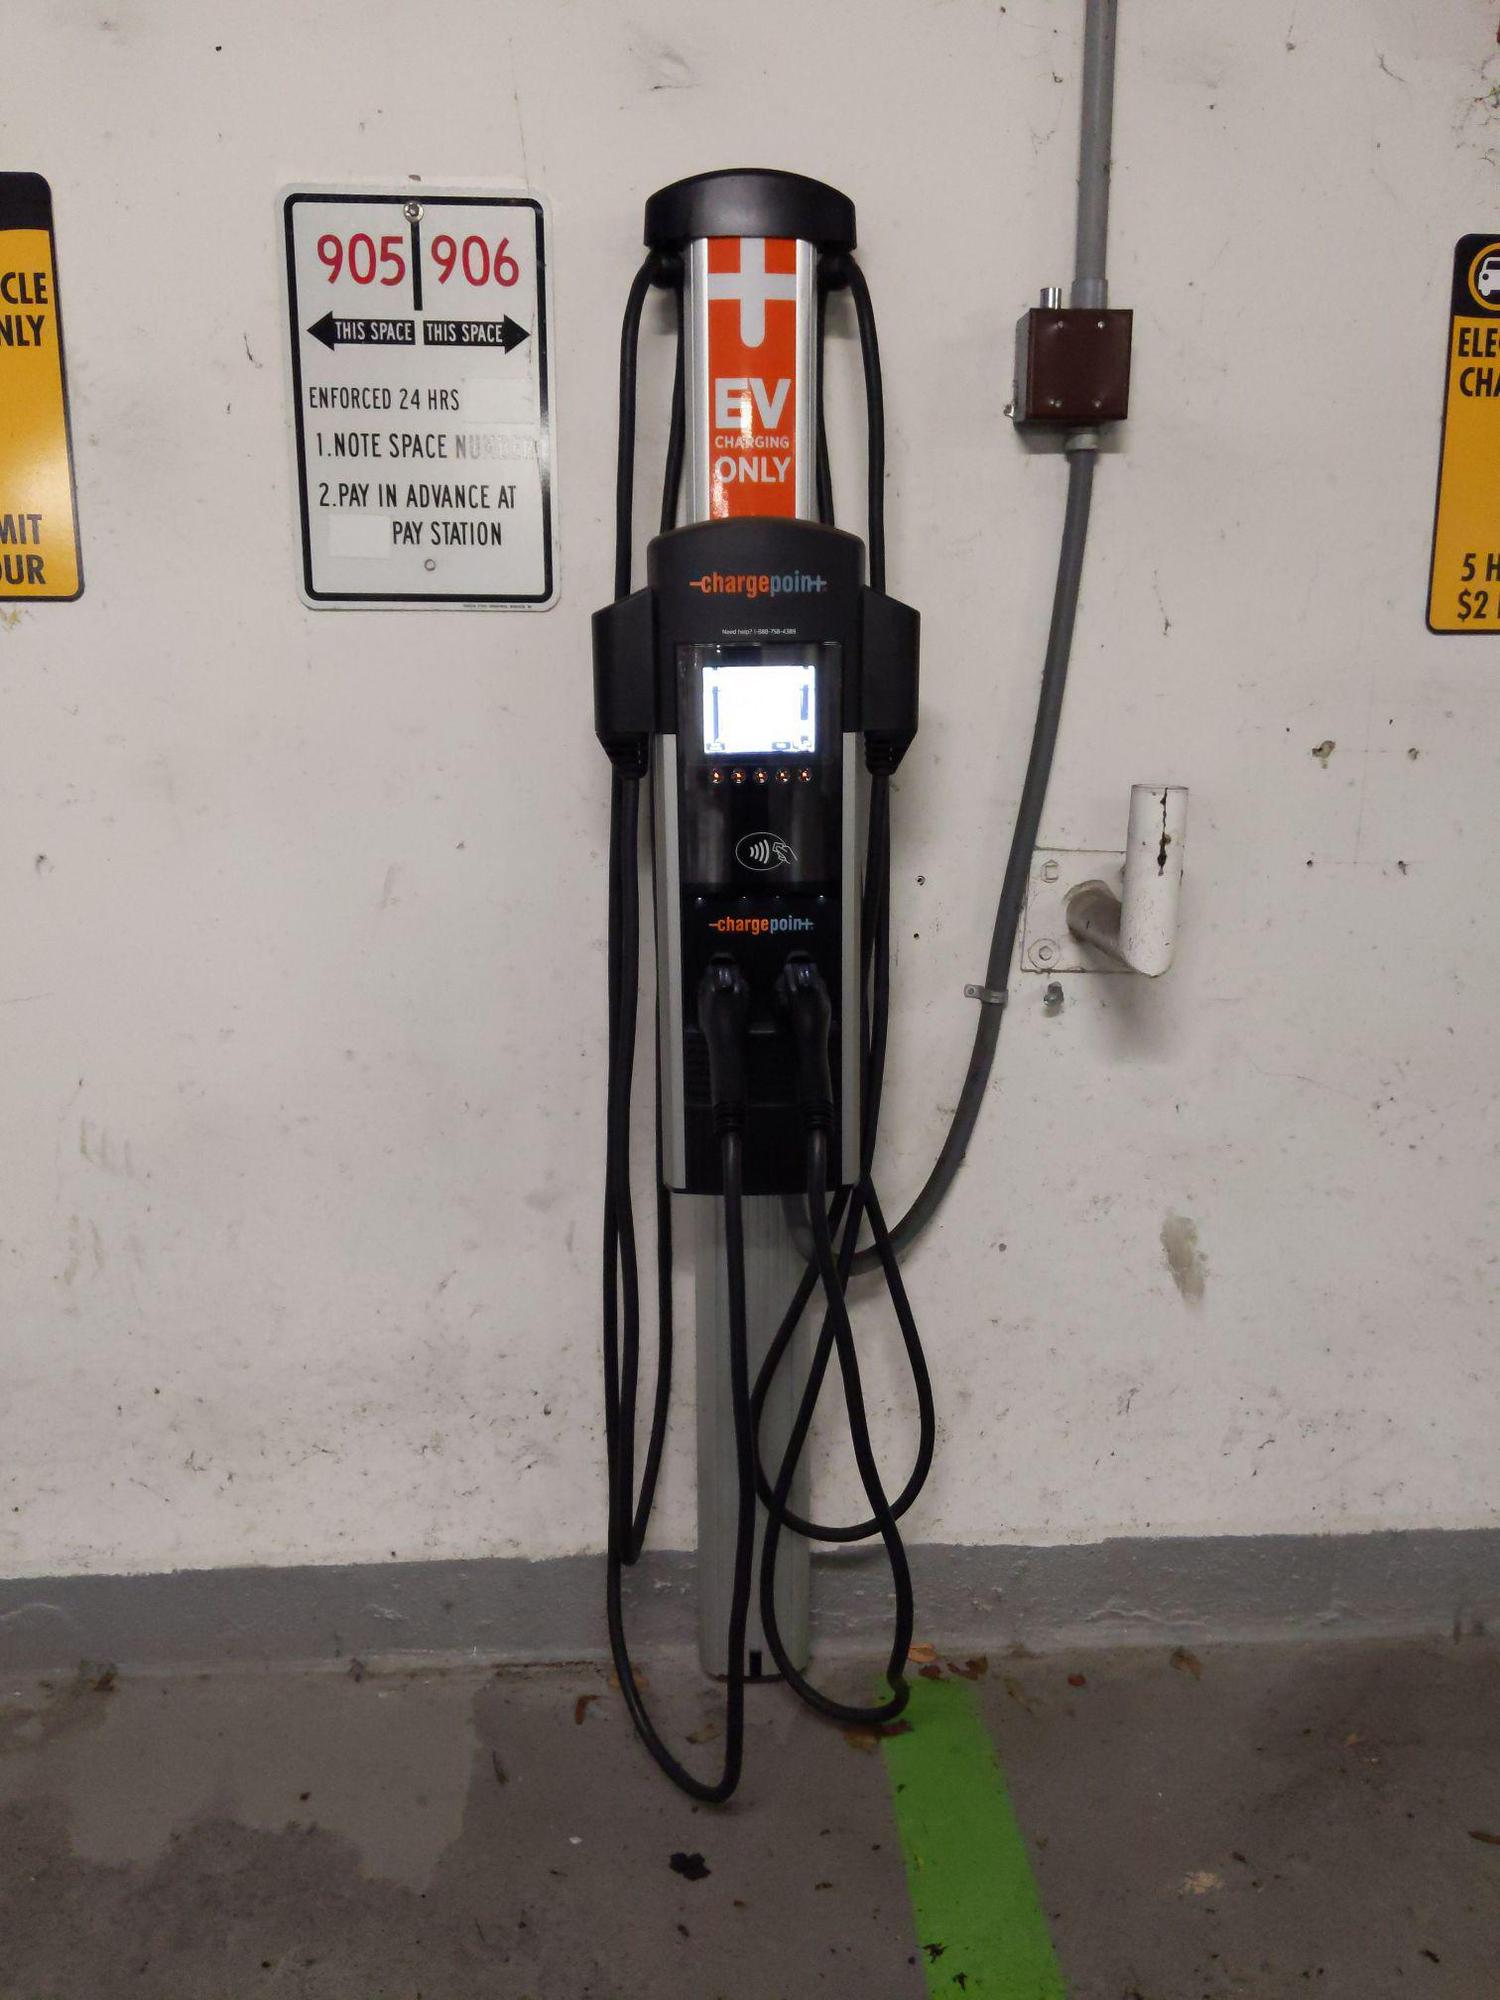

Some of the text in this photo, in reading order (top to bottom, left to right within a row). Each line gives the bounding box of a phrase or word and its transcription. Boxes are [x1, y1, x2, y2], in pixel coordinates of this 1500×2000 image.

[317, 233, 519, 286] 905 906
[335, 321, 413, 342] THIS SPACE
[426, 322, 504, 344] THIS SPACE
[309, 387, 460, 411] ENFORCED 24 HRS
[714, 377, 792, 429] EV
[389, 434, 447, 458] SPACE
[715, 435, 790, 449] CHARGING
[716, 456, 792, 483] ONLY
[319, 483, 517, 509] 2.PAY IN ADVANCE AT
[392, 521, 502, 545] PAY STATION
[1461, 553, 1477, 581] 5
[1457, 587, 1489, 622] $2
